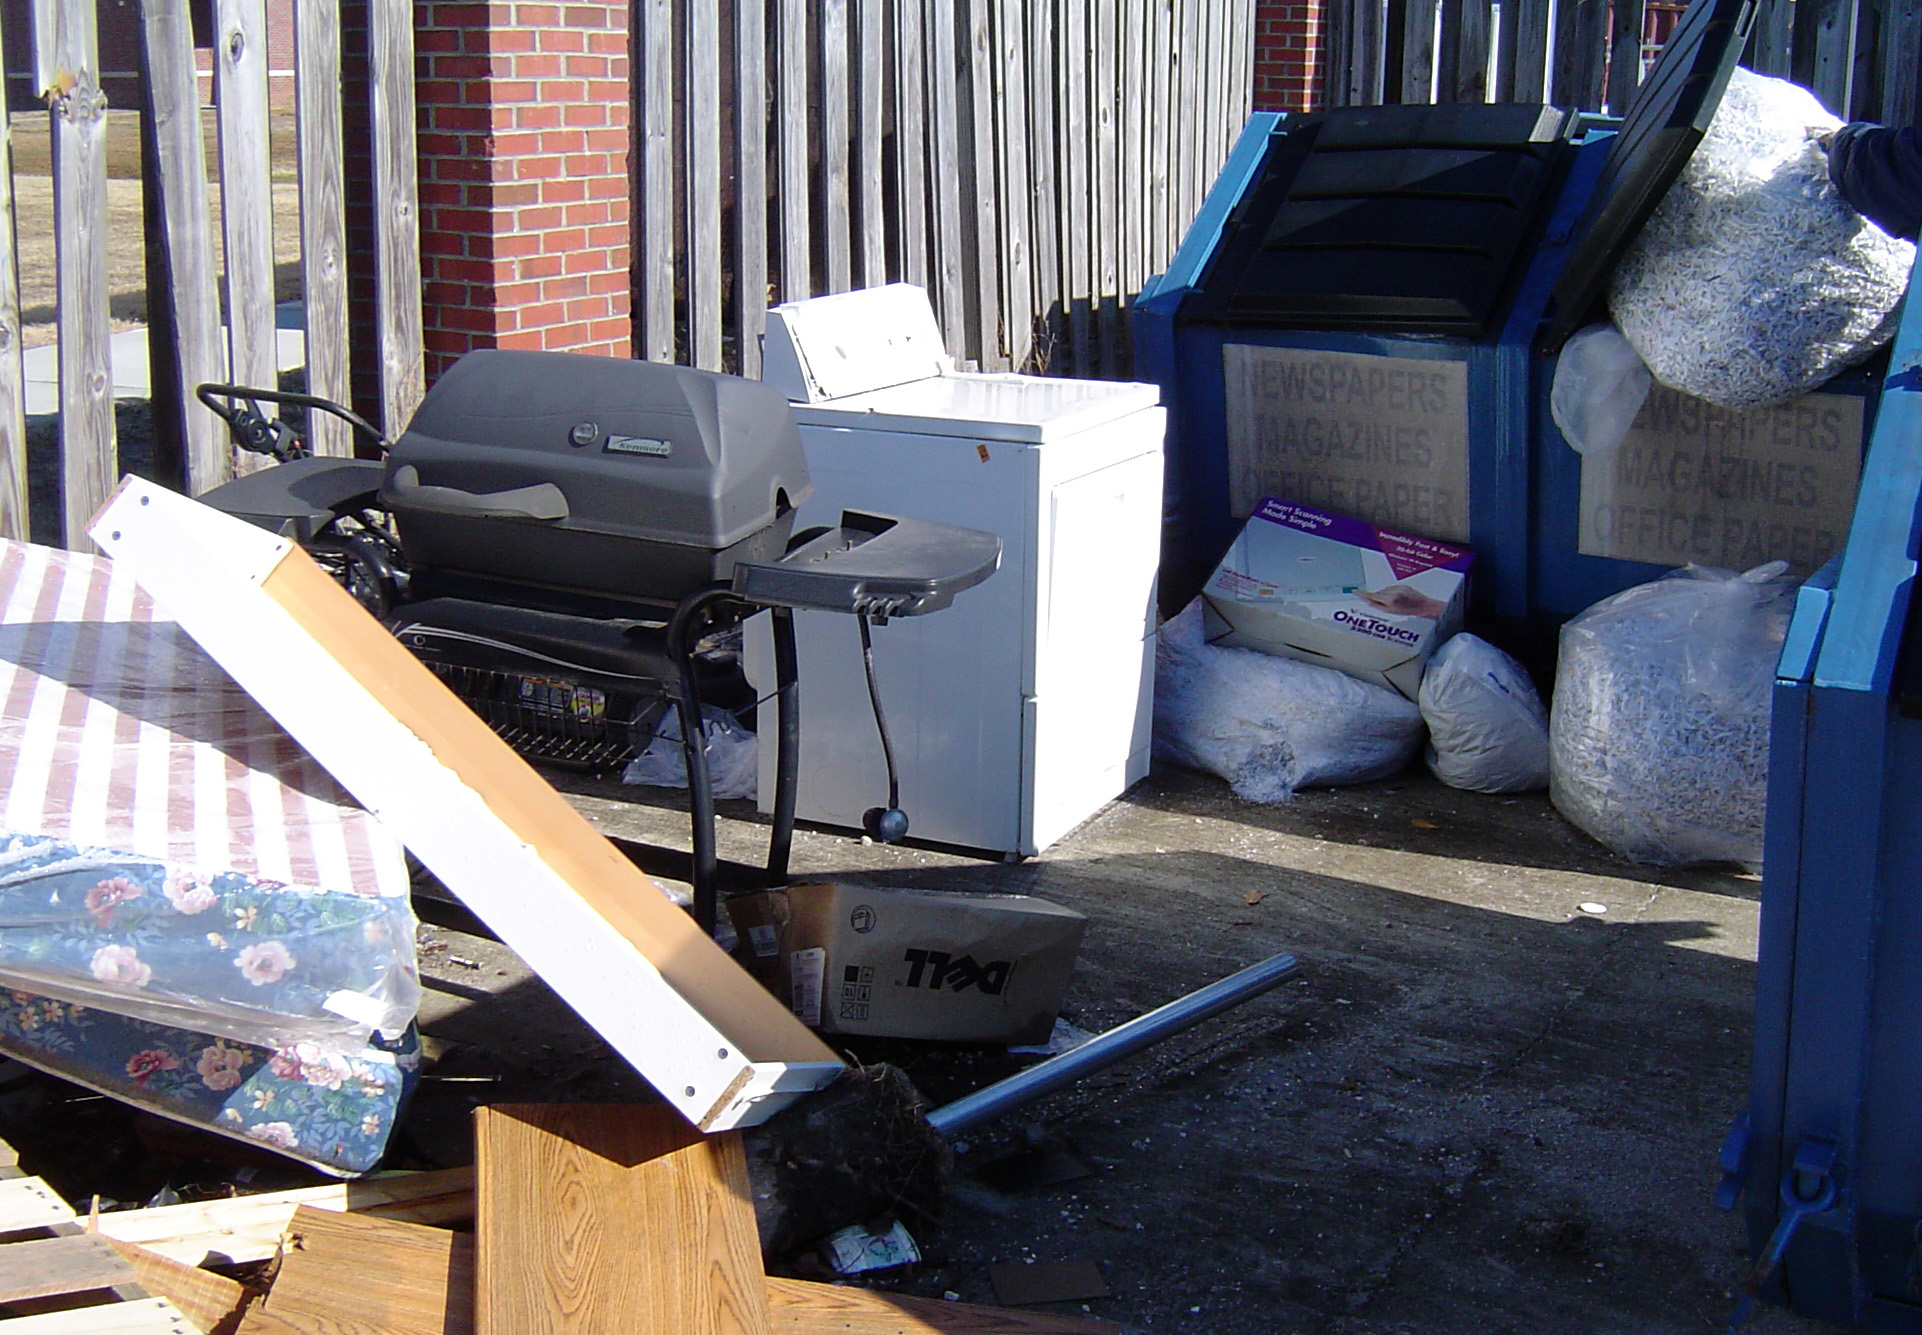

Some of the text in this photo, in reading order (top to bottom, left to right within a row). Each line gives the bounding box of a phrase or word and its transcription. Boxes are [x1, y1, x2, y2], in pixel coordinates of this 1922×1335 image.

[618, 442, 669, 454] Kenmore
[1255, 414, 1432, 468] MAGAZINES
[1615, 447, 1819, 507] MAGAZINES
[1262, 507, 1317, 529] Made Simple
[1266, 500, 1333, 527] Smart Scanning
[1355, 478, 1457, 527] PAPER
[1593, 504, 1715, 555] OFFICE
[904, 947, 1012, 996] DELL
